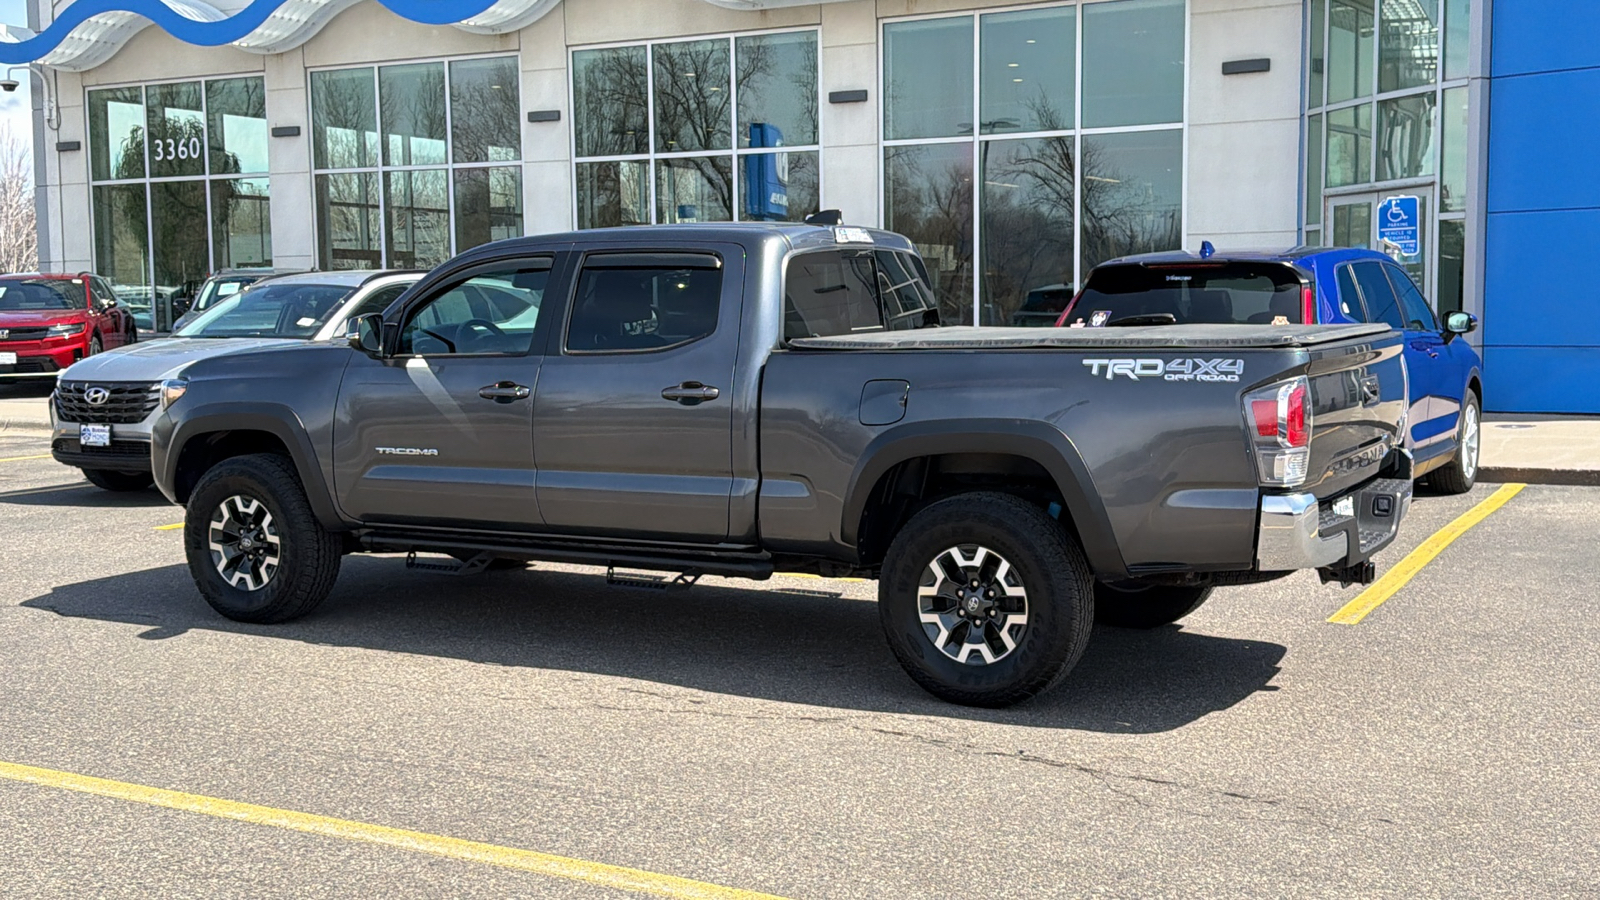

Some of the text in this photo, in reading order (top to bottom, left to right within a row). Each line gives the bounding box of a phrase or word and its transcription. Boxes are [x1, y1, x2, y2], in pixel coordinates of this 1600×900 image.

[154, 137, 200, 161] 3360
[1082, 359, 1165, 381] TRD
[1196, 374, 1240, 382] ROAD
[375, 447, 439, 455] TACOMA
